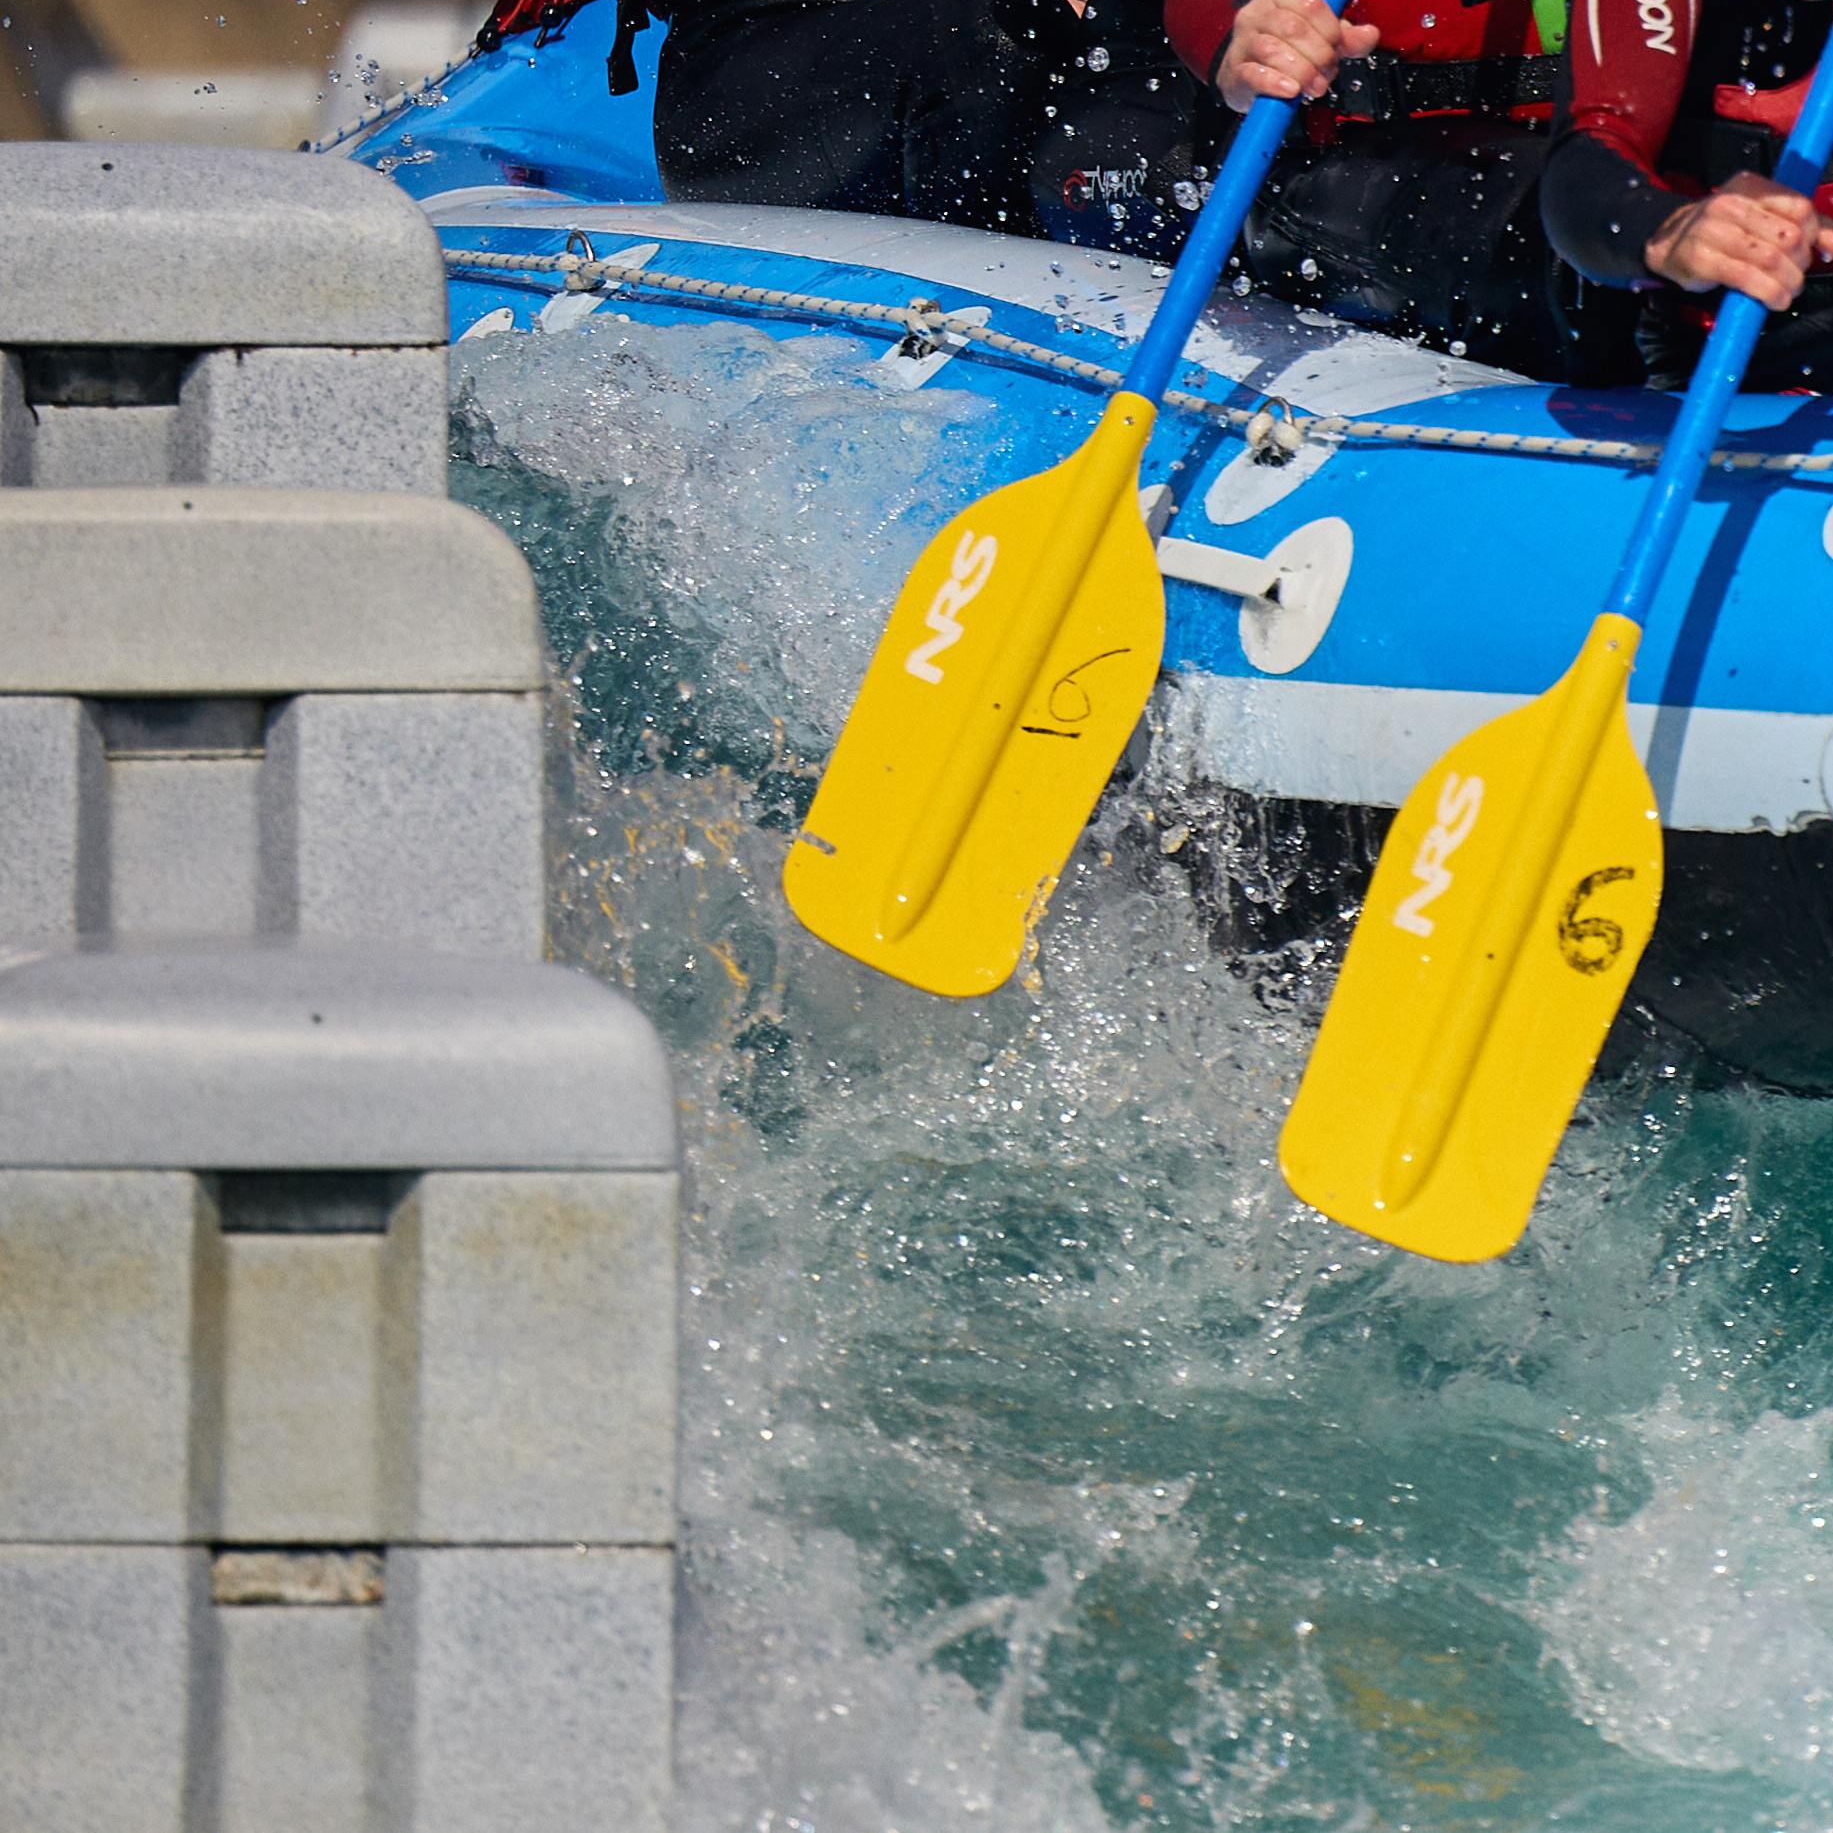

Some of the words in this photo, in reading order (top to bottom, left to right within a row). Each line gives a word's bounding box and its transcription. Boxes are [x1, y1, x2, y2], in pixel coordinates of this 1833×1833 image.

[904, 529, 998, 686] NRS
[1392, 771, 1485, 939] NRS
[1558, 866, 1635, 978] 6
